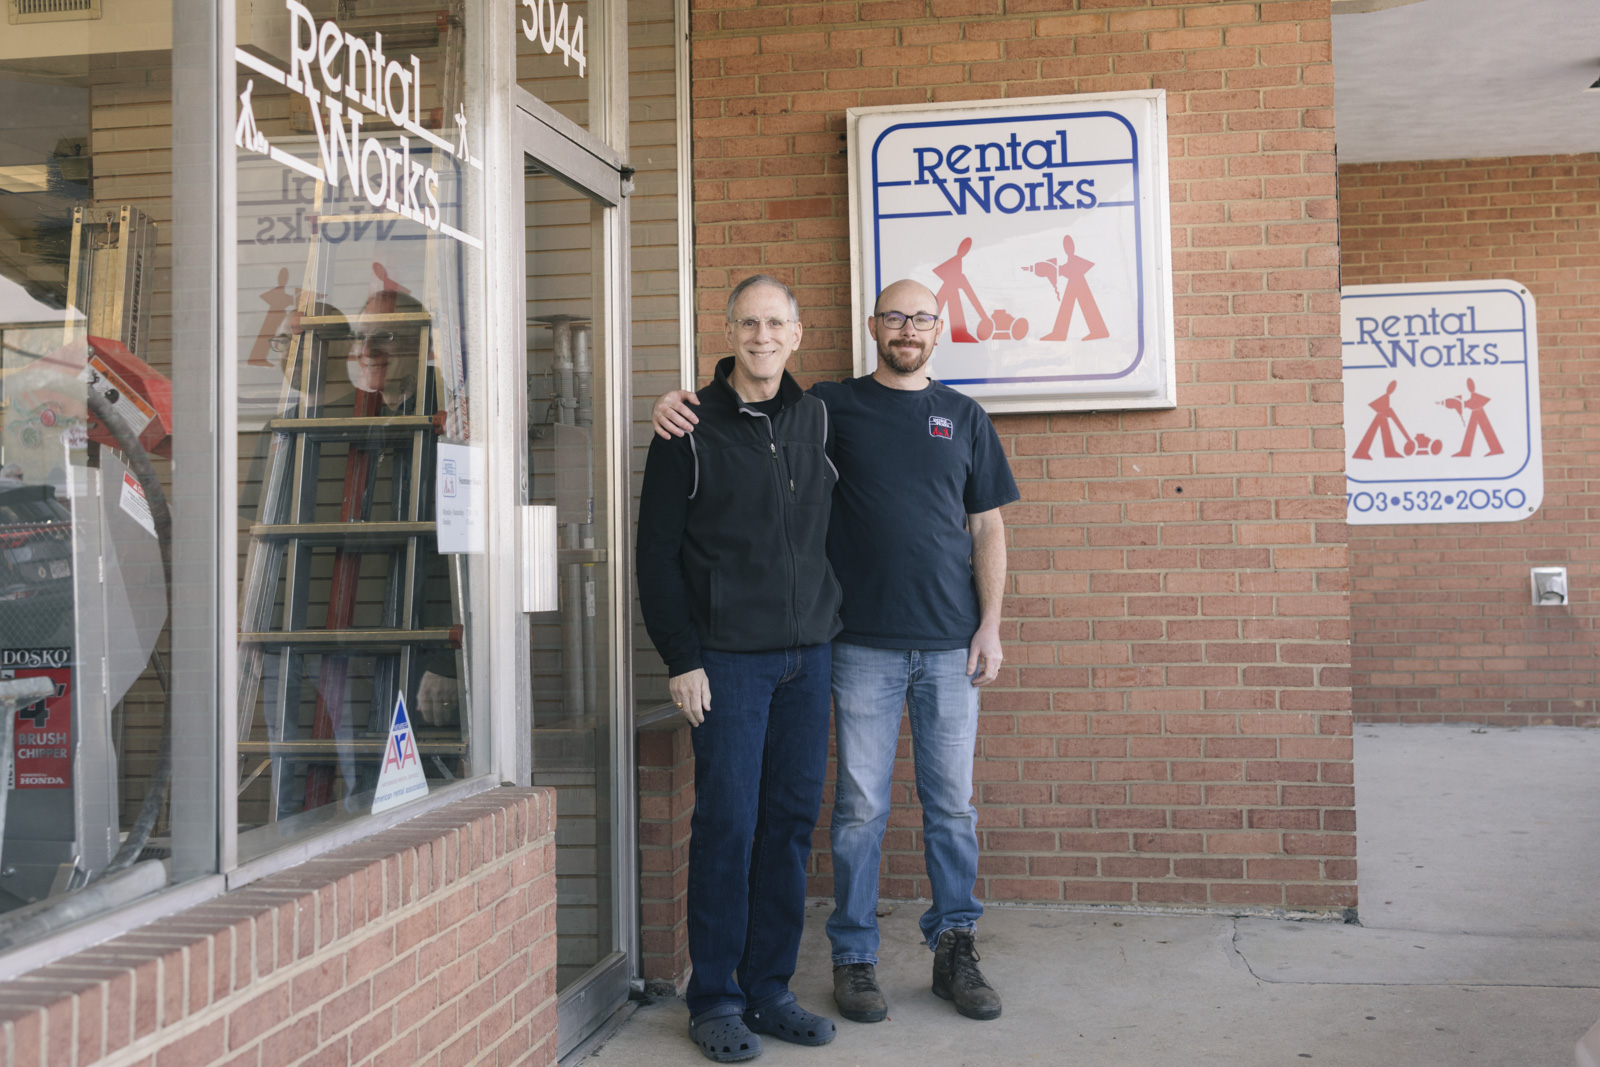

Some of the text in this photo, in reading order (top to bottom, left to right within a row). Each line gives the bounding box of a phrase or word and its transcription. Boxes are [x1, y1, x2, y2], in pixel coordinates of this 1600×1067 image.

[522, 0, 586, 79] 5044
[286, 0, 420, 127] Rental
[309, 94, 441, 230] Works
[913, 130, 1068, 185] Rental
[935, 172, 1098, 215] Works
[1356, 306, 1476, 345] Rental
[1374, 338, 1500, 368] Works
[3, 649, 69, 668] DOSKO
[18, 733, 66, 745] BRUSH
[18, 748, 67, 759] CHIPPER
[20, 777, 64, 785] HONDA
